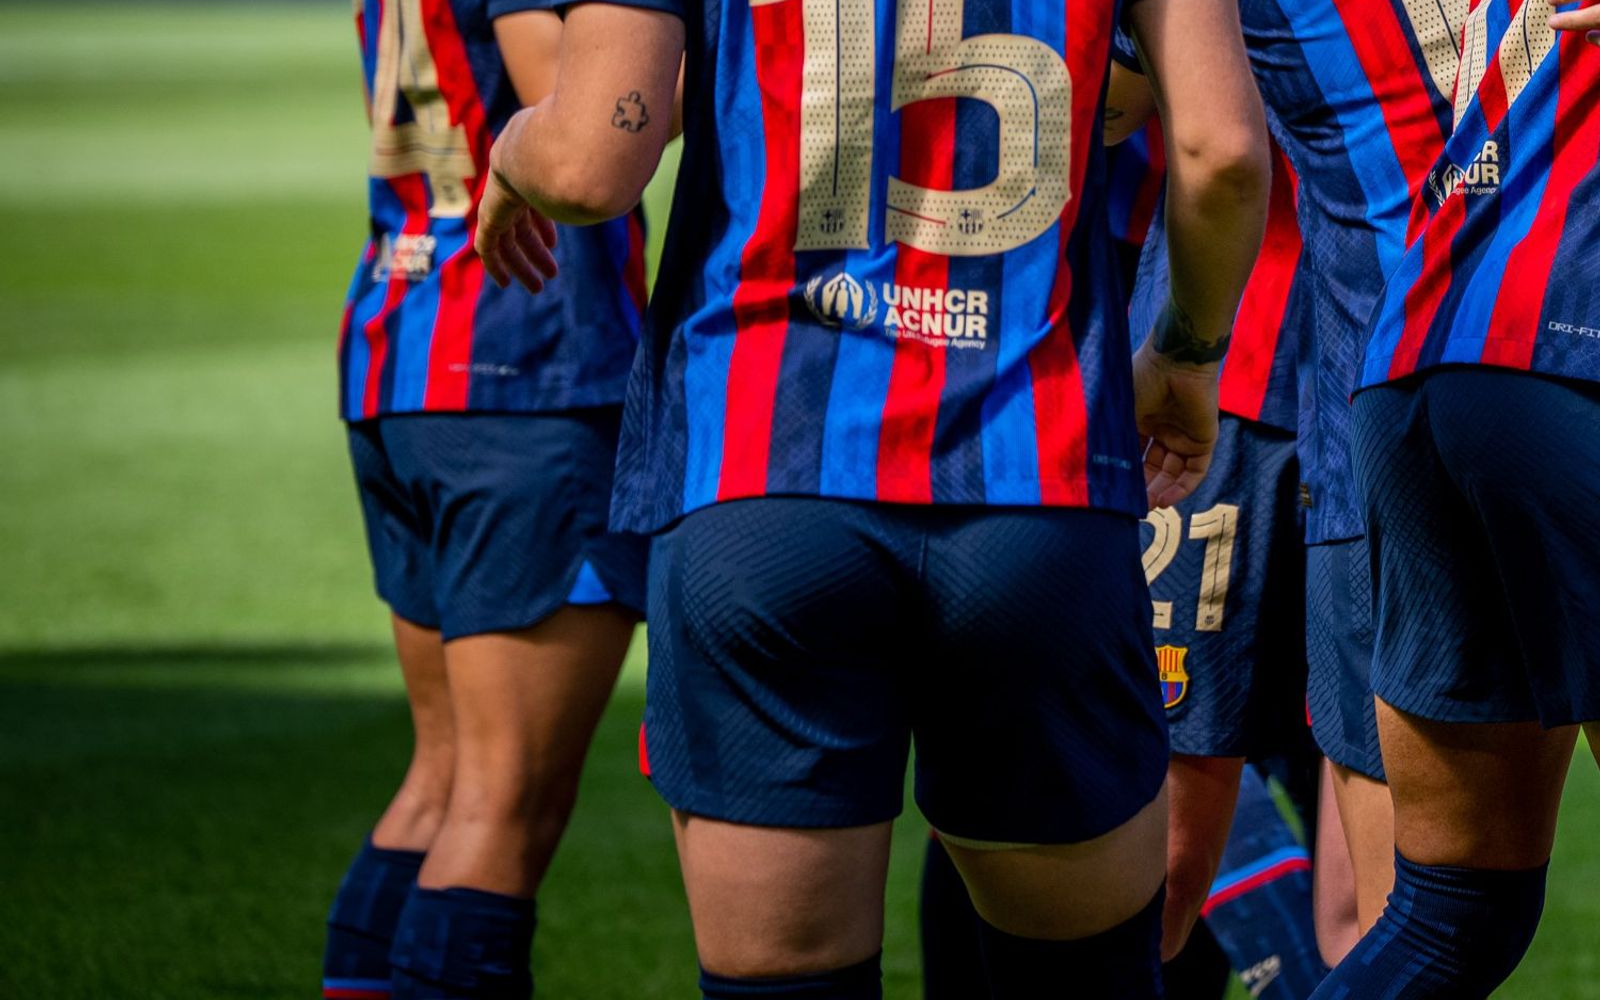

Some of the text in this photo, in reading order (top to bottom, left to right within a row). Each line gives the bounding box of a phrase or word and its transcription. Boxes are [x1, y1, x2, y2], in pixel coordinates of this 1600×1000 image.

[883, 282, 988, 315] UNHCR
[884, 306, 987, 338] ACNUR
[951, 338, 985, 350] Agency
[1138, 503, 1240, 632] 21
